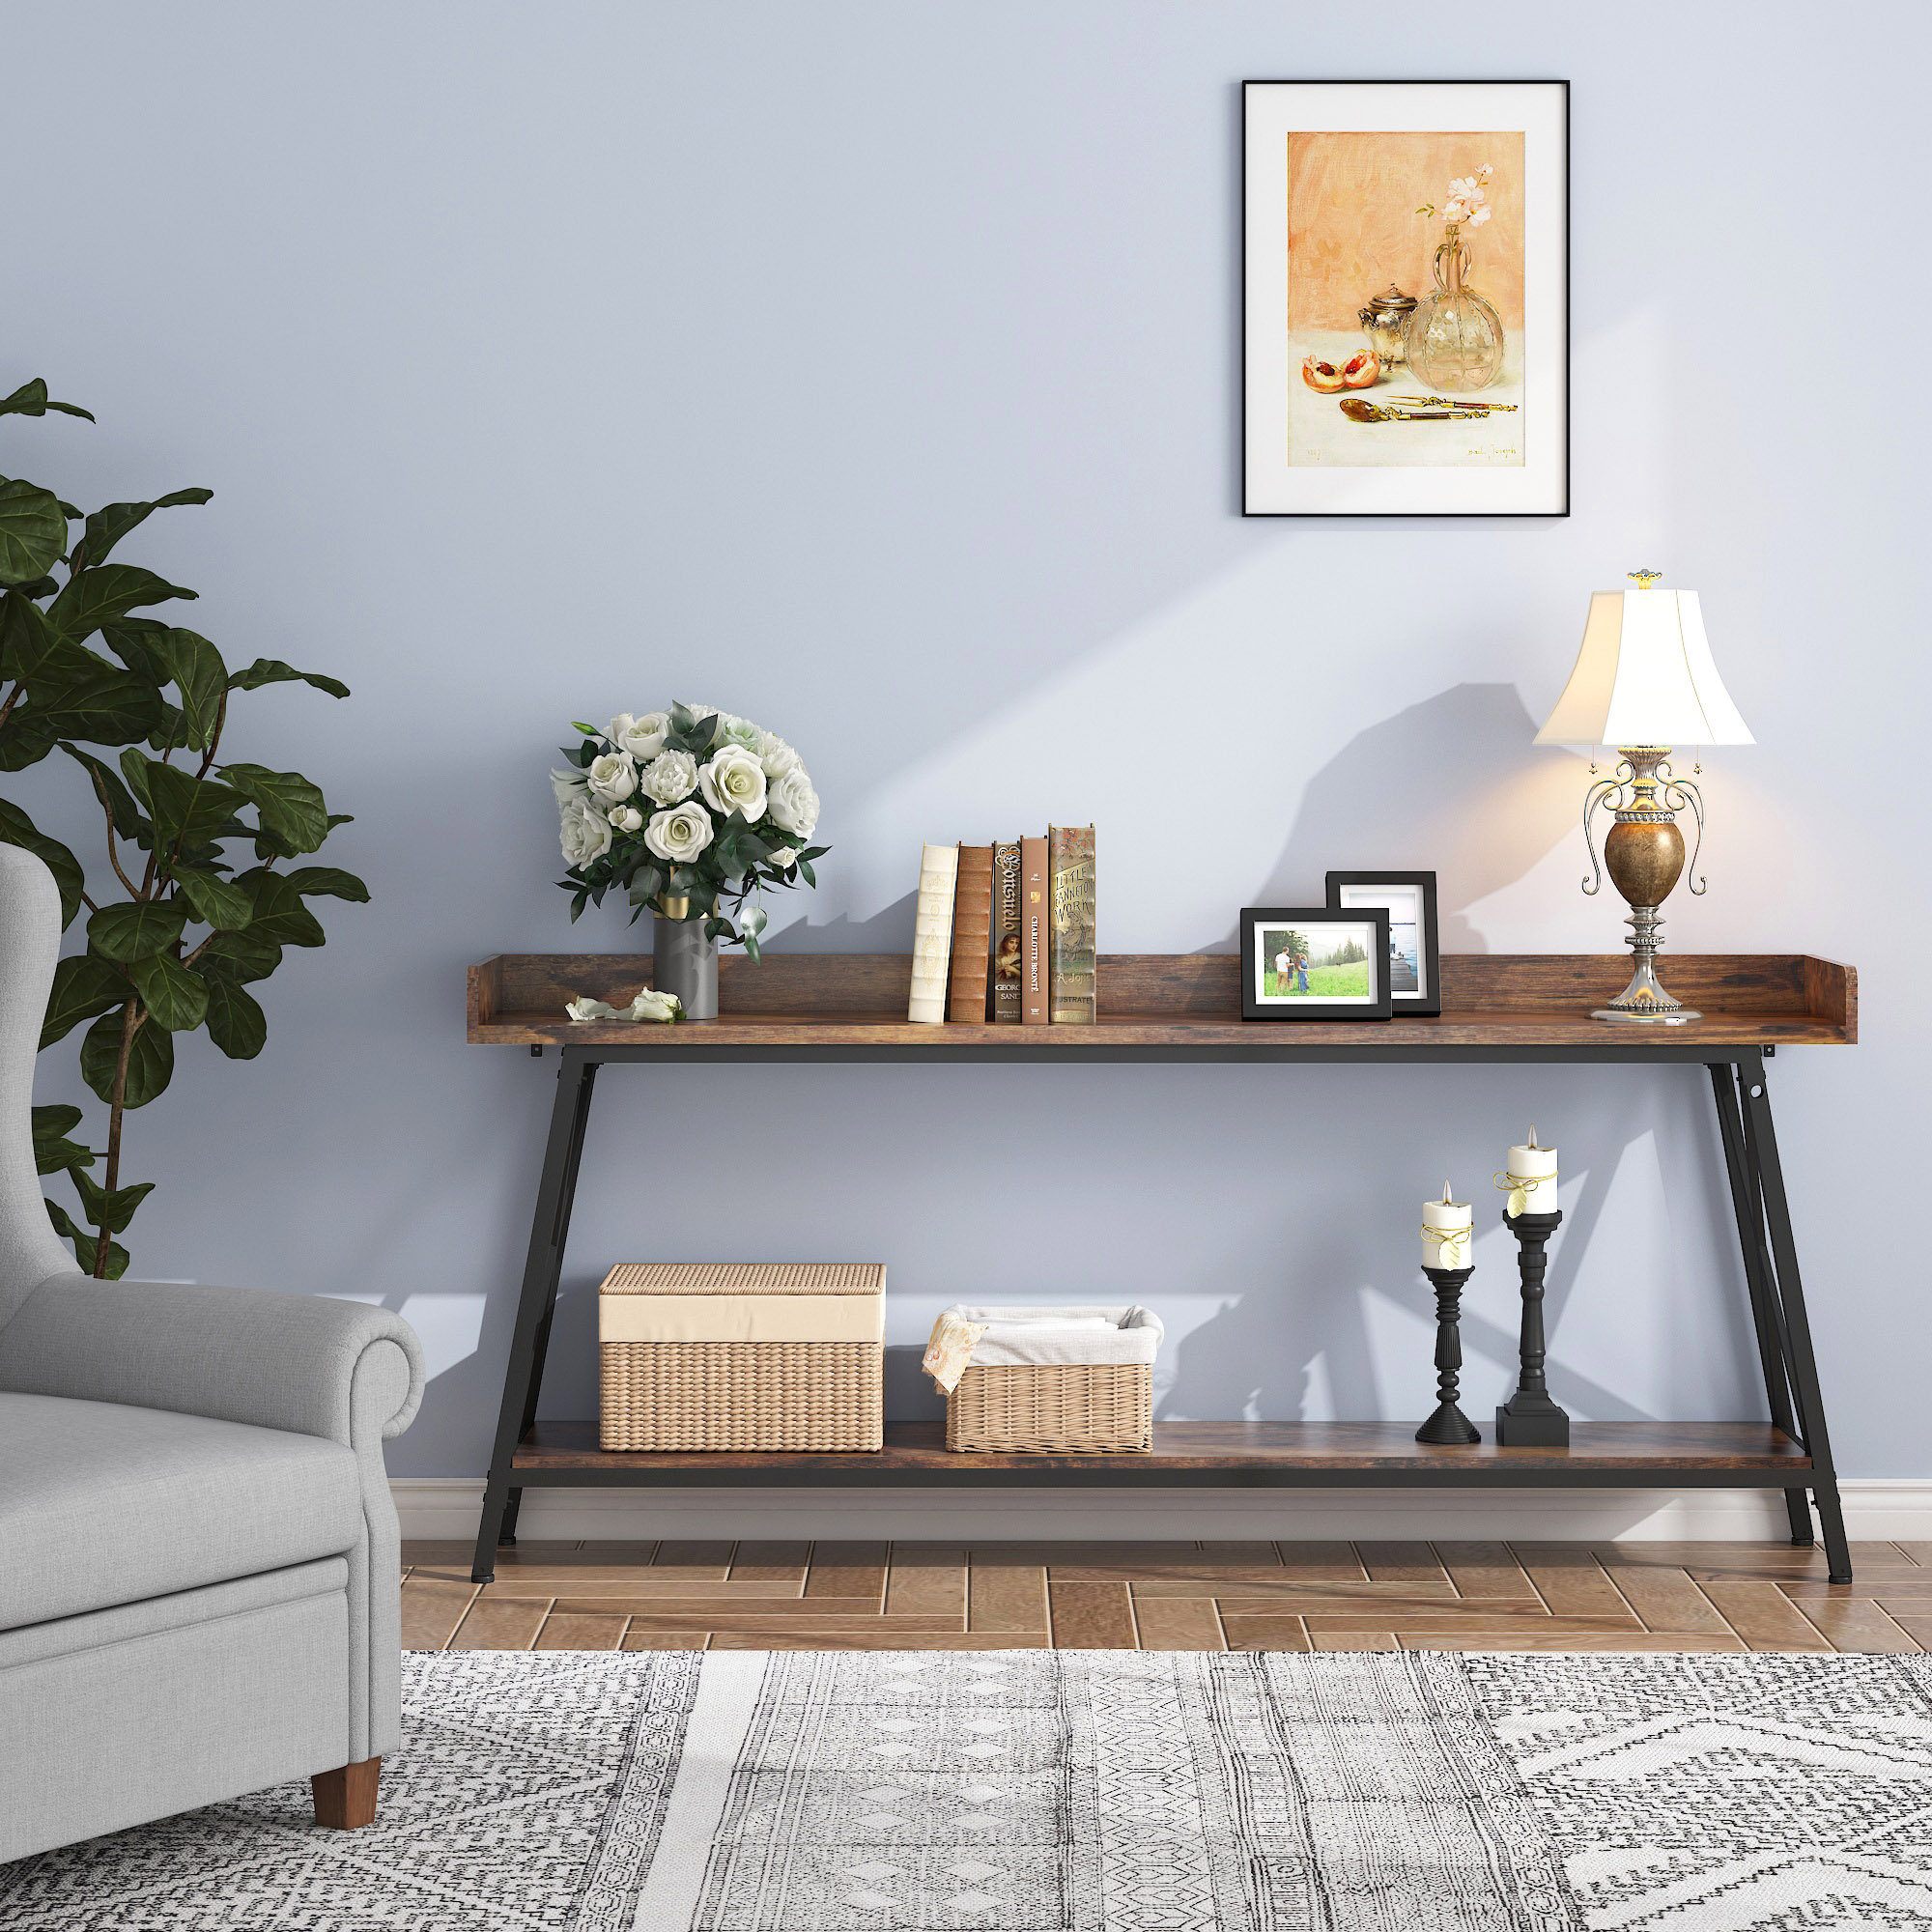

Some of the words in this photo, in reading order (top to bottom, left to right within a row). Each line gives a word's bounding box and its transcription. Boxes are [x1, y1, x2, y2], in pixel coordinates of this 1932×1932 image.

[1056, 867, 1087, 891] LITTLE
[1054, 896, 1093, 924] WORK
[1031, 915, 1039, 961] CHARLOTTE
